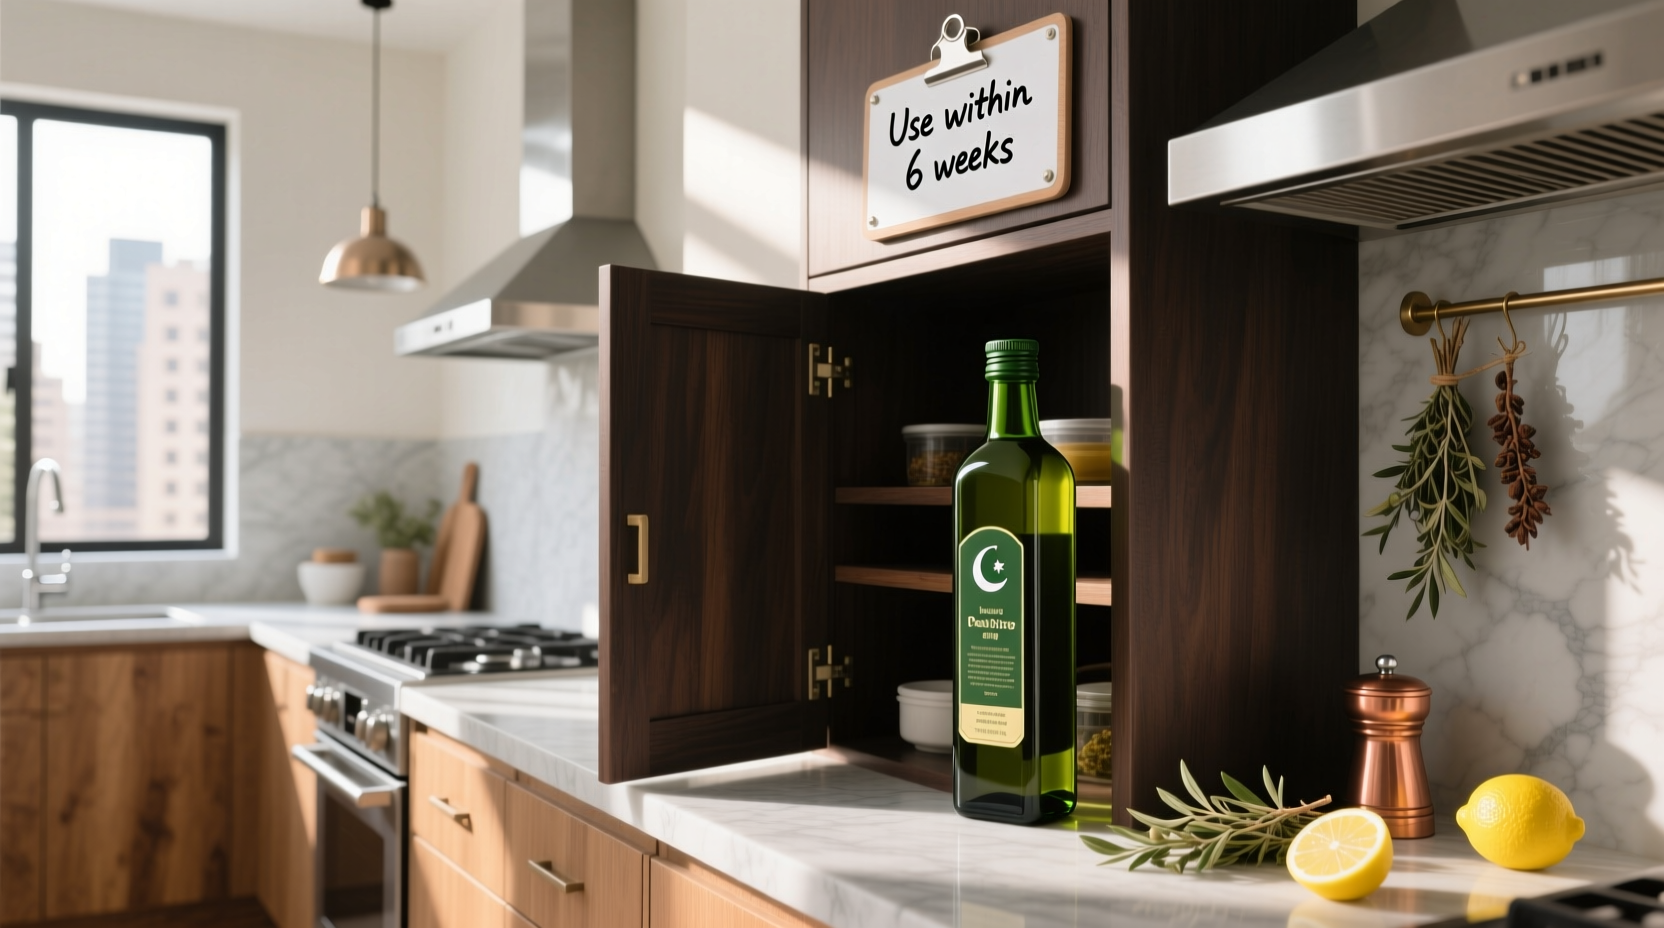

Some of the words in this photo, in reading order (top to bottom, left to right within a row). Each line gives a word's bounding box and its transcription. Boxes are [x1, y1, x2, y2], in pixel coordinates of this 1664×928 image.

[889, 107, 934, 147] Use
[944, 79, 1033, 130] within
[905, 148, 923, 191] 6
[933, 130, 1014, 182] weeks
